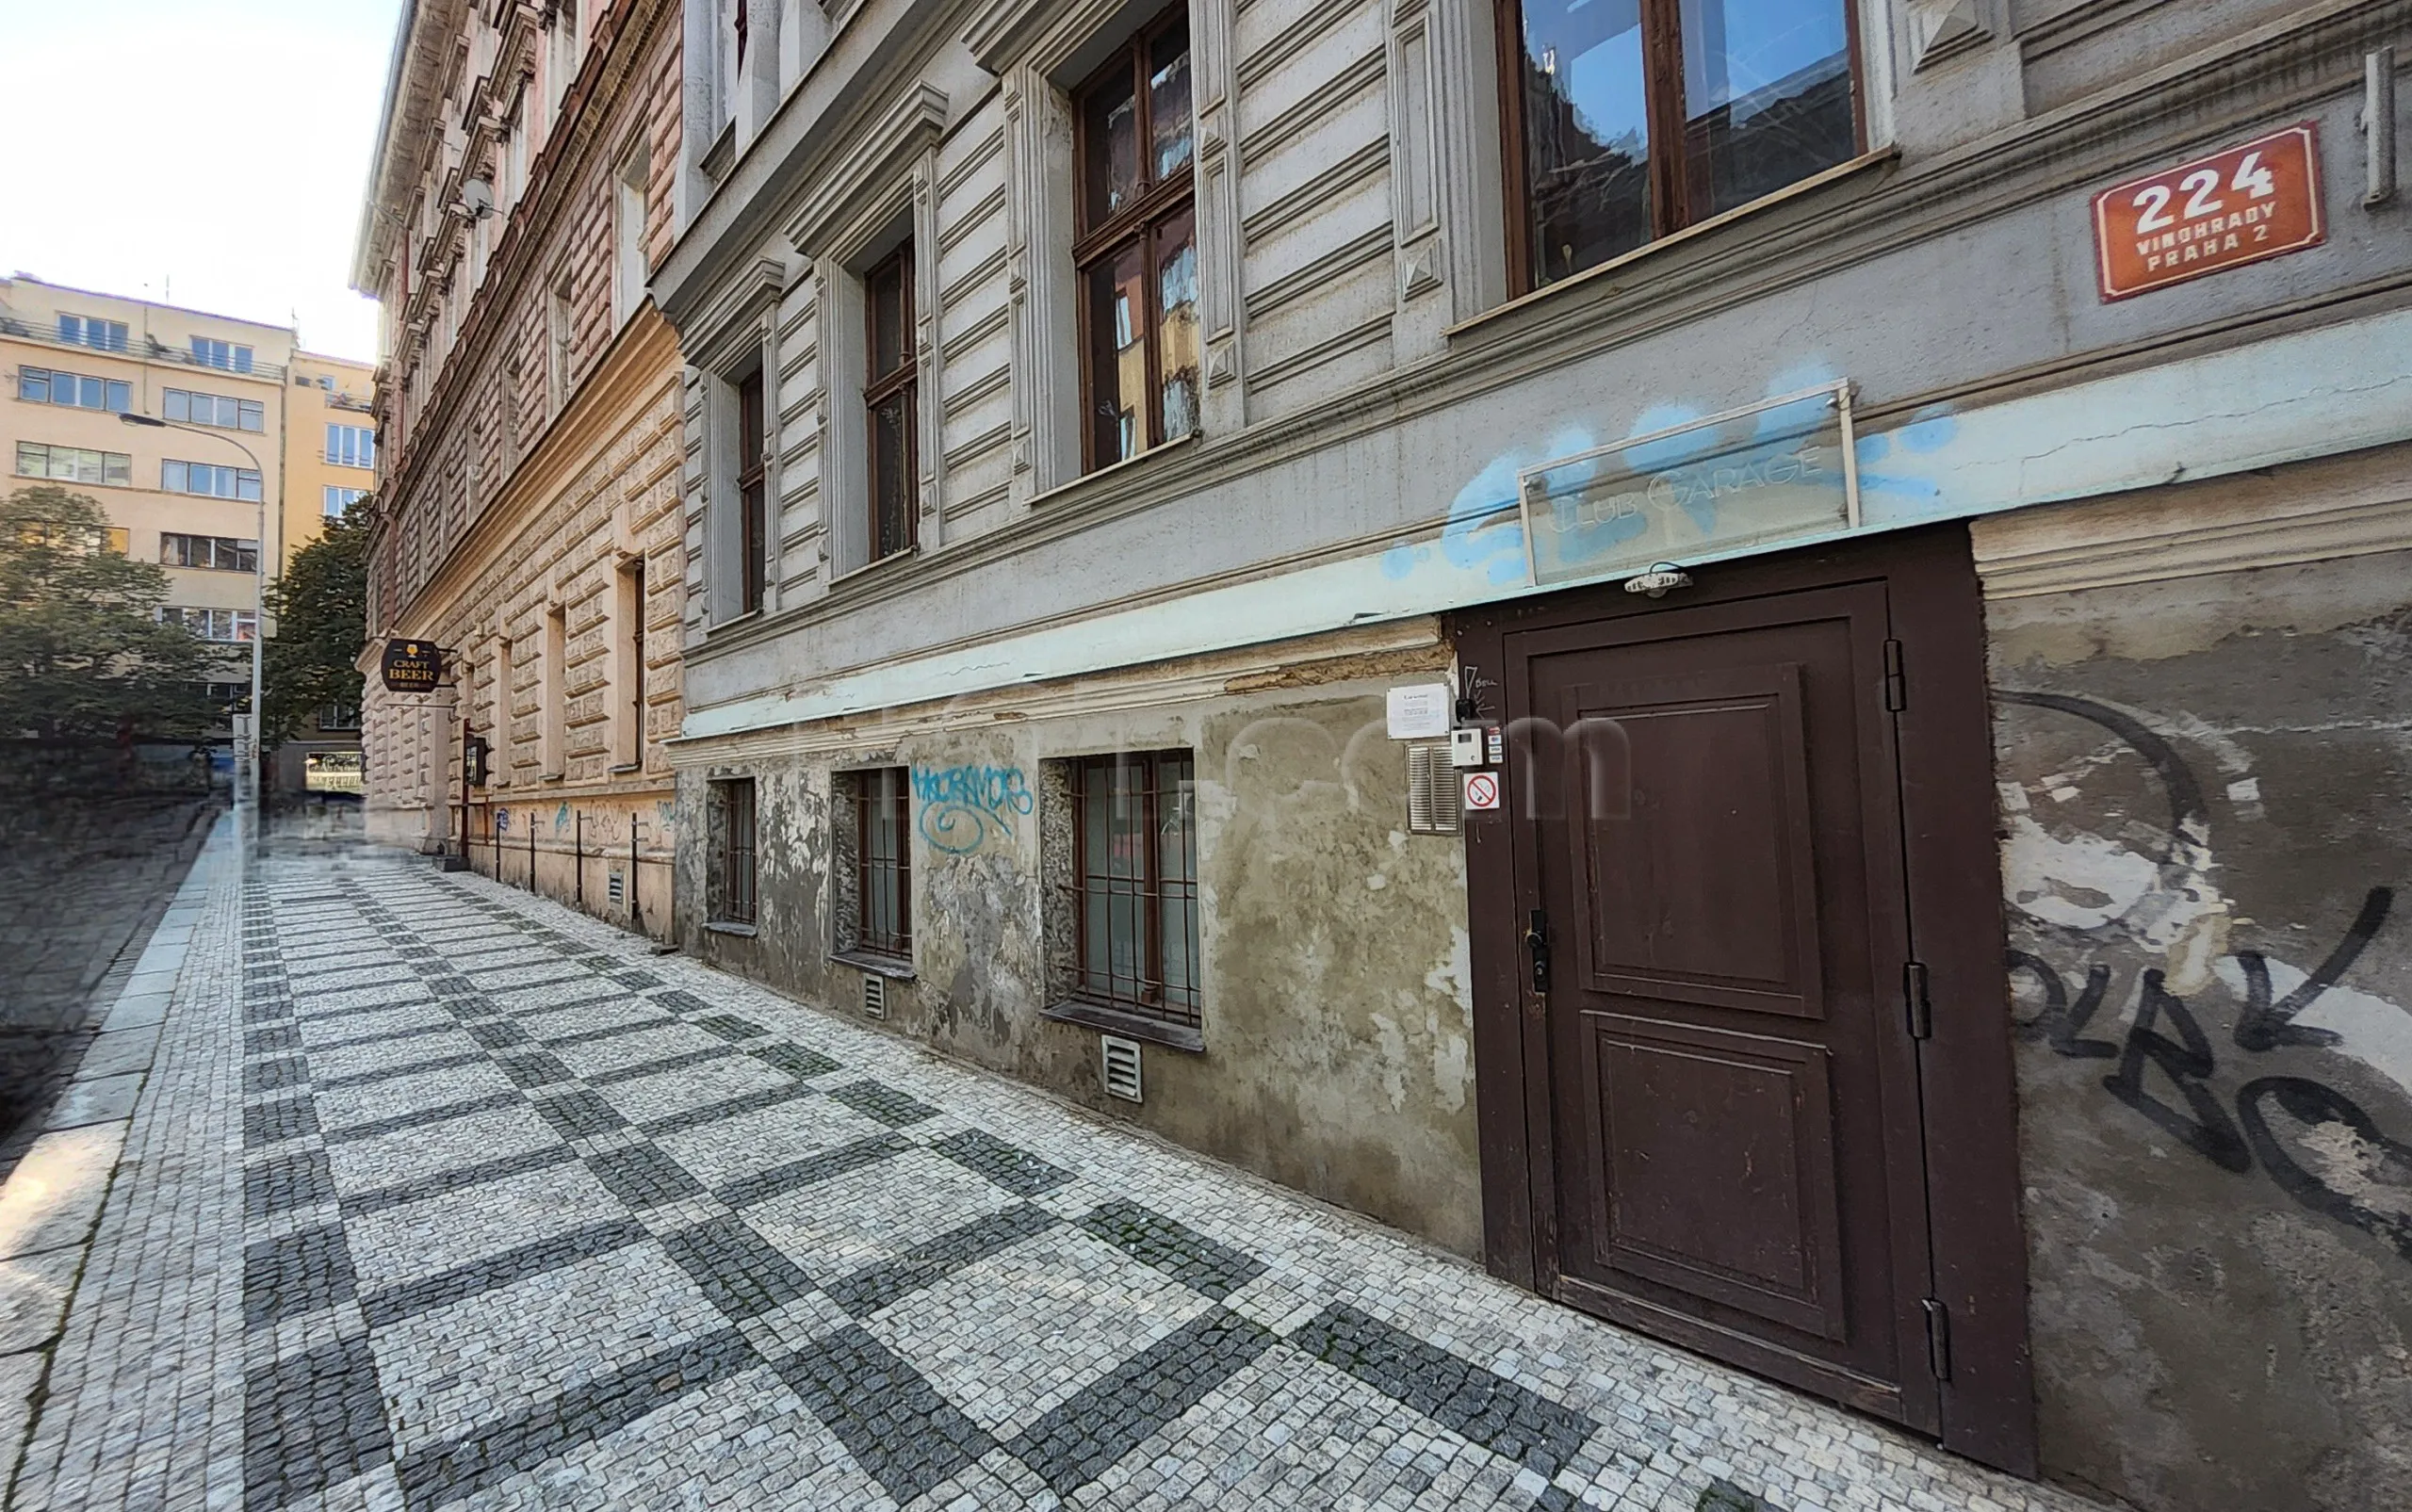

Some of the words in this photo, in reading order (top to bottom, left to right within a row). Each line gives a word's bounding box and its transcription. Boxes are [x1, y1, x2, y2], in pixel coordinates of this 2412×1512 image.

[2133, 151, 2274, 235] 224
[2135, 202, 2276, 256] VINOHRADY
[2147, 233, 2240, 273] PRAHA
[2253, 223, 2270, 242] 2
[389, 669, 434, 680] BEER
[394, 660, 431, 670] CRAFT
